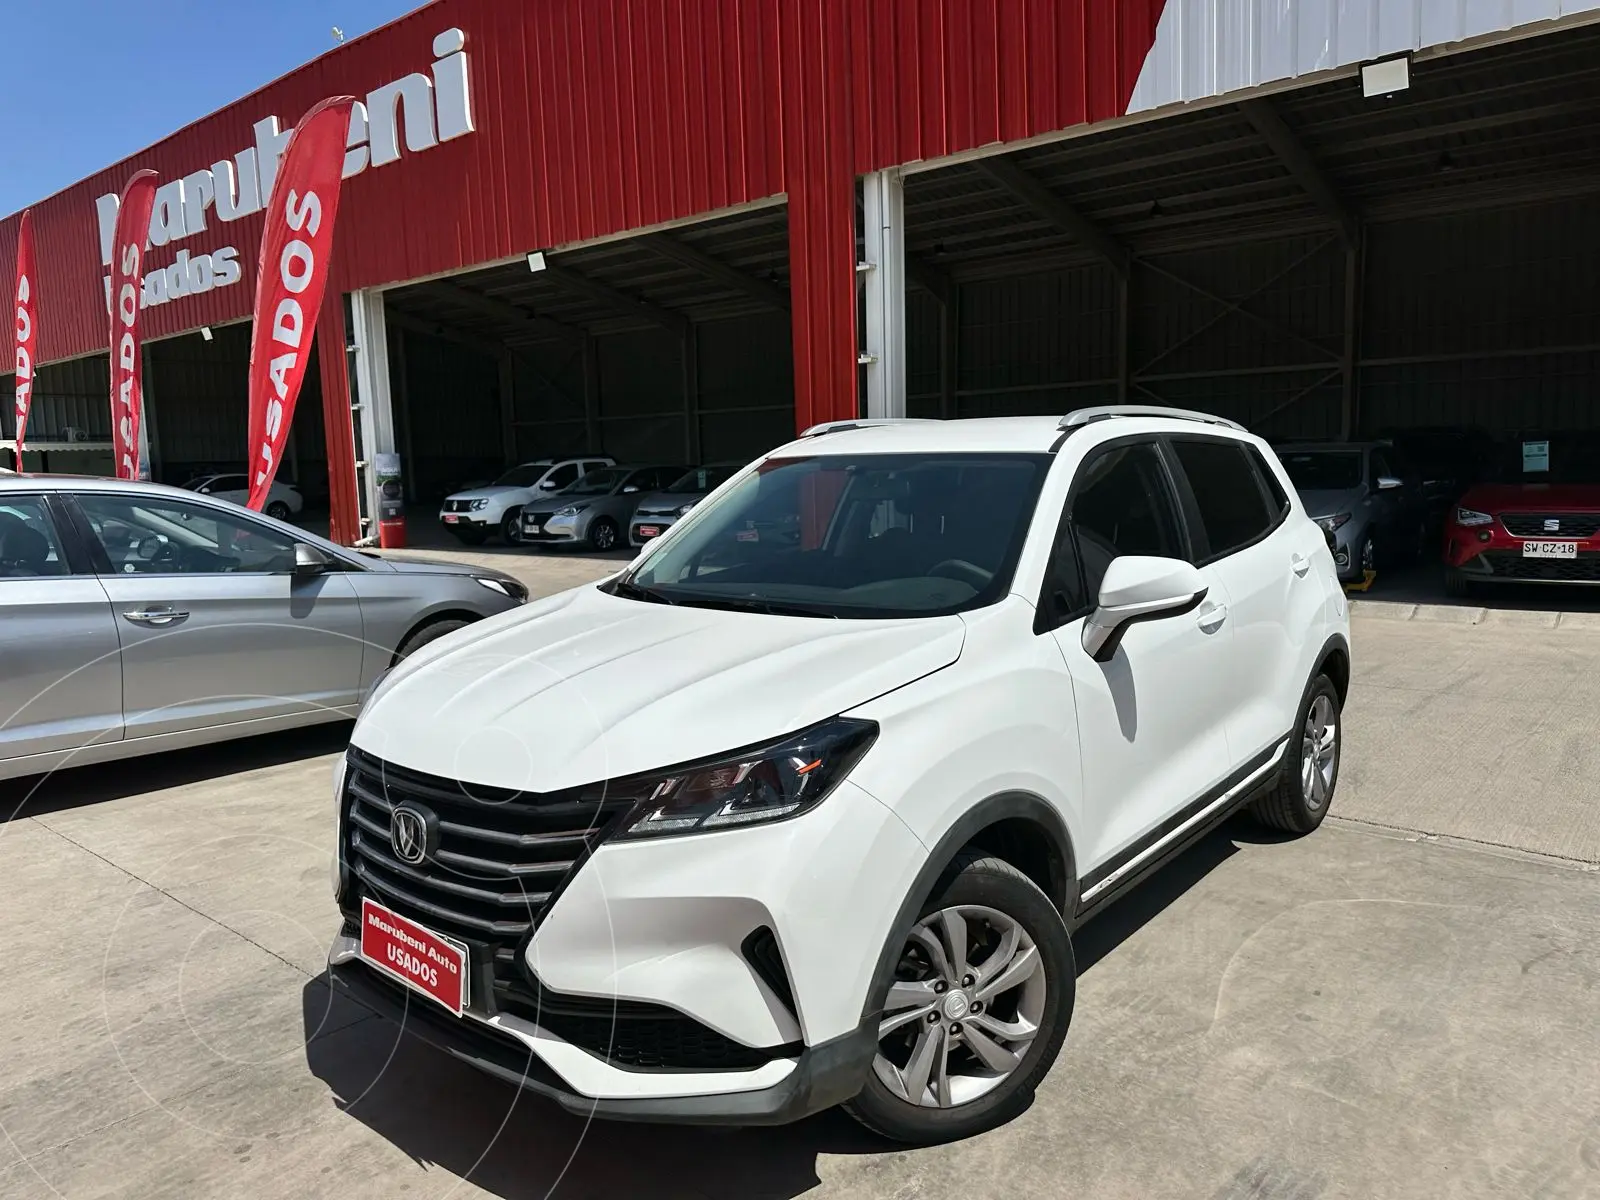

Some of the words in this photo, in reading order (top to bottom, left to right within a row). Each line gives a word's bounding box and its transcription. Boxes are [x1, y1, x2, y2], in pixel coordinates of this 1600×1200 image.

[368, 913, 426, 954] Marubeni
[428, 946, 457, 975] Auto
[387, 942, 438, 987] USADOS
